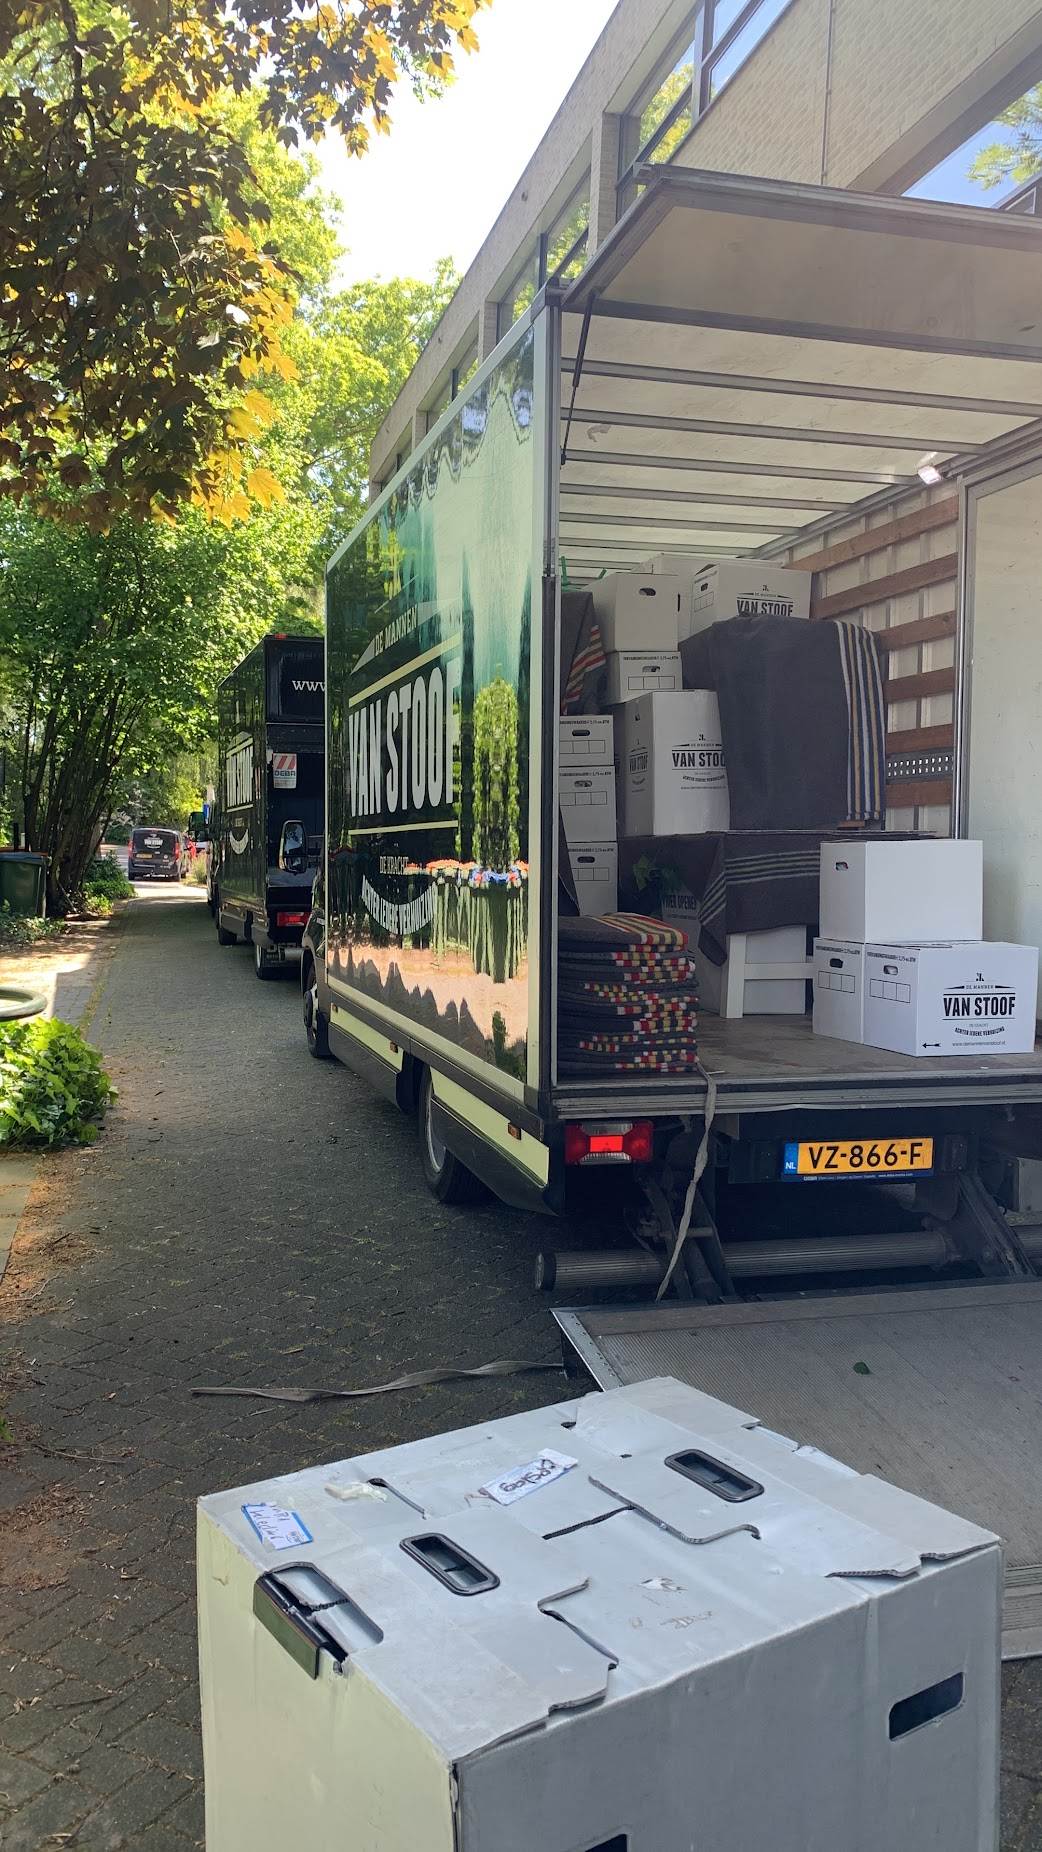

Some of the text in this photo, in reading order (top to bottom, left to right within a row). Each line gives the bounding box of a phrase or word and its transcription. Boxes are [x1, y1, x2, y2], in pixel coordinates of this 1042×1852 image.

[375, 604, 417, 656] DE MANNEN
[349, 656, 462, 817] VAN STOOF
[672, 752, 695, 767] VAN
[943, 996, 1016, 1016] VAN STOOF
[785, 1162, 797, 1170] NL
[808, 1142, 923, 1169] VZ-866-F
